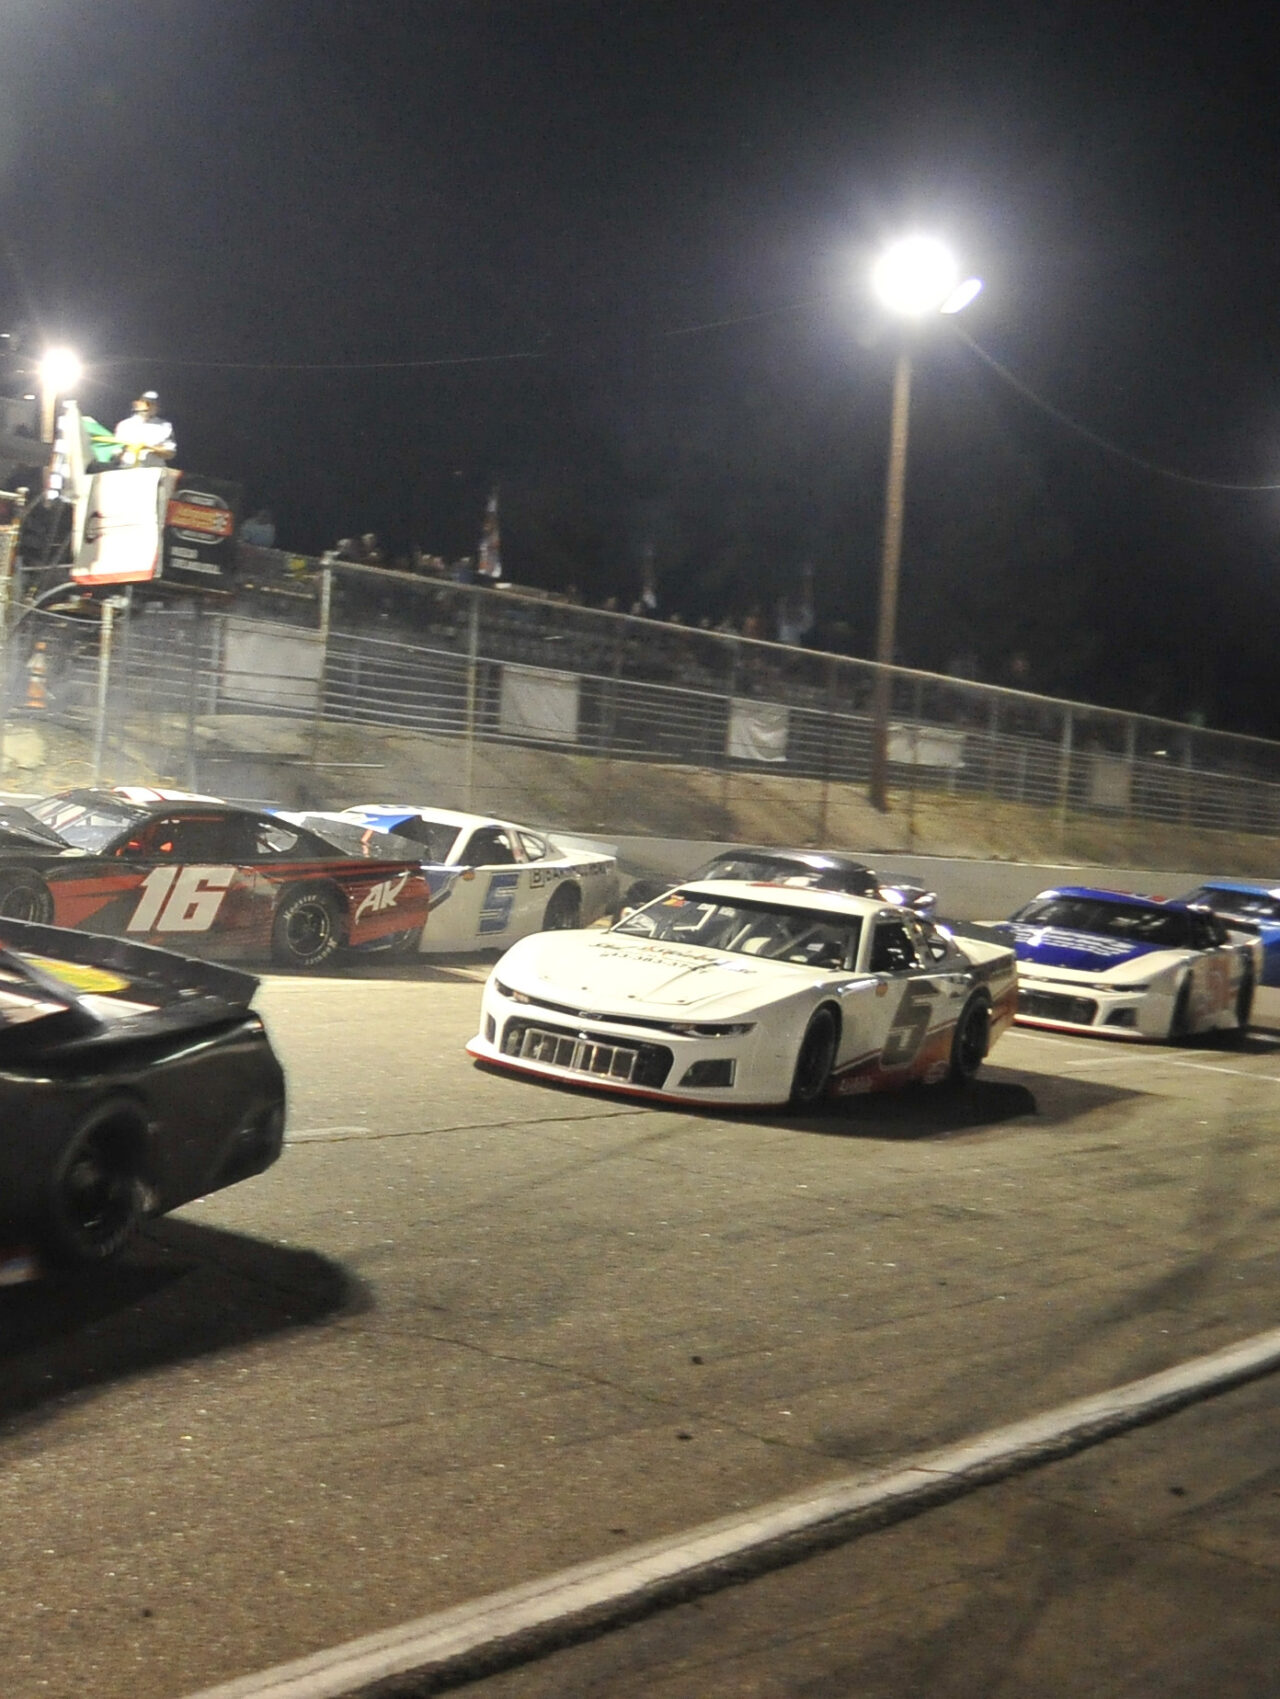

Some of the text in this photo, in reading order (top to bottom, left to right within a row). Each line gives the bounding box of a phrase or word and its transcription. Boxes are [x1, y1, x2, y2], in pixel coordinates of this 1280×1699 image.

[125, 865, 239, 933] 16
[354, 870, 412, 926] AK
[475, 871, 521, 937] 5
[879, 976, 942, 1072] 5
